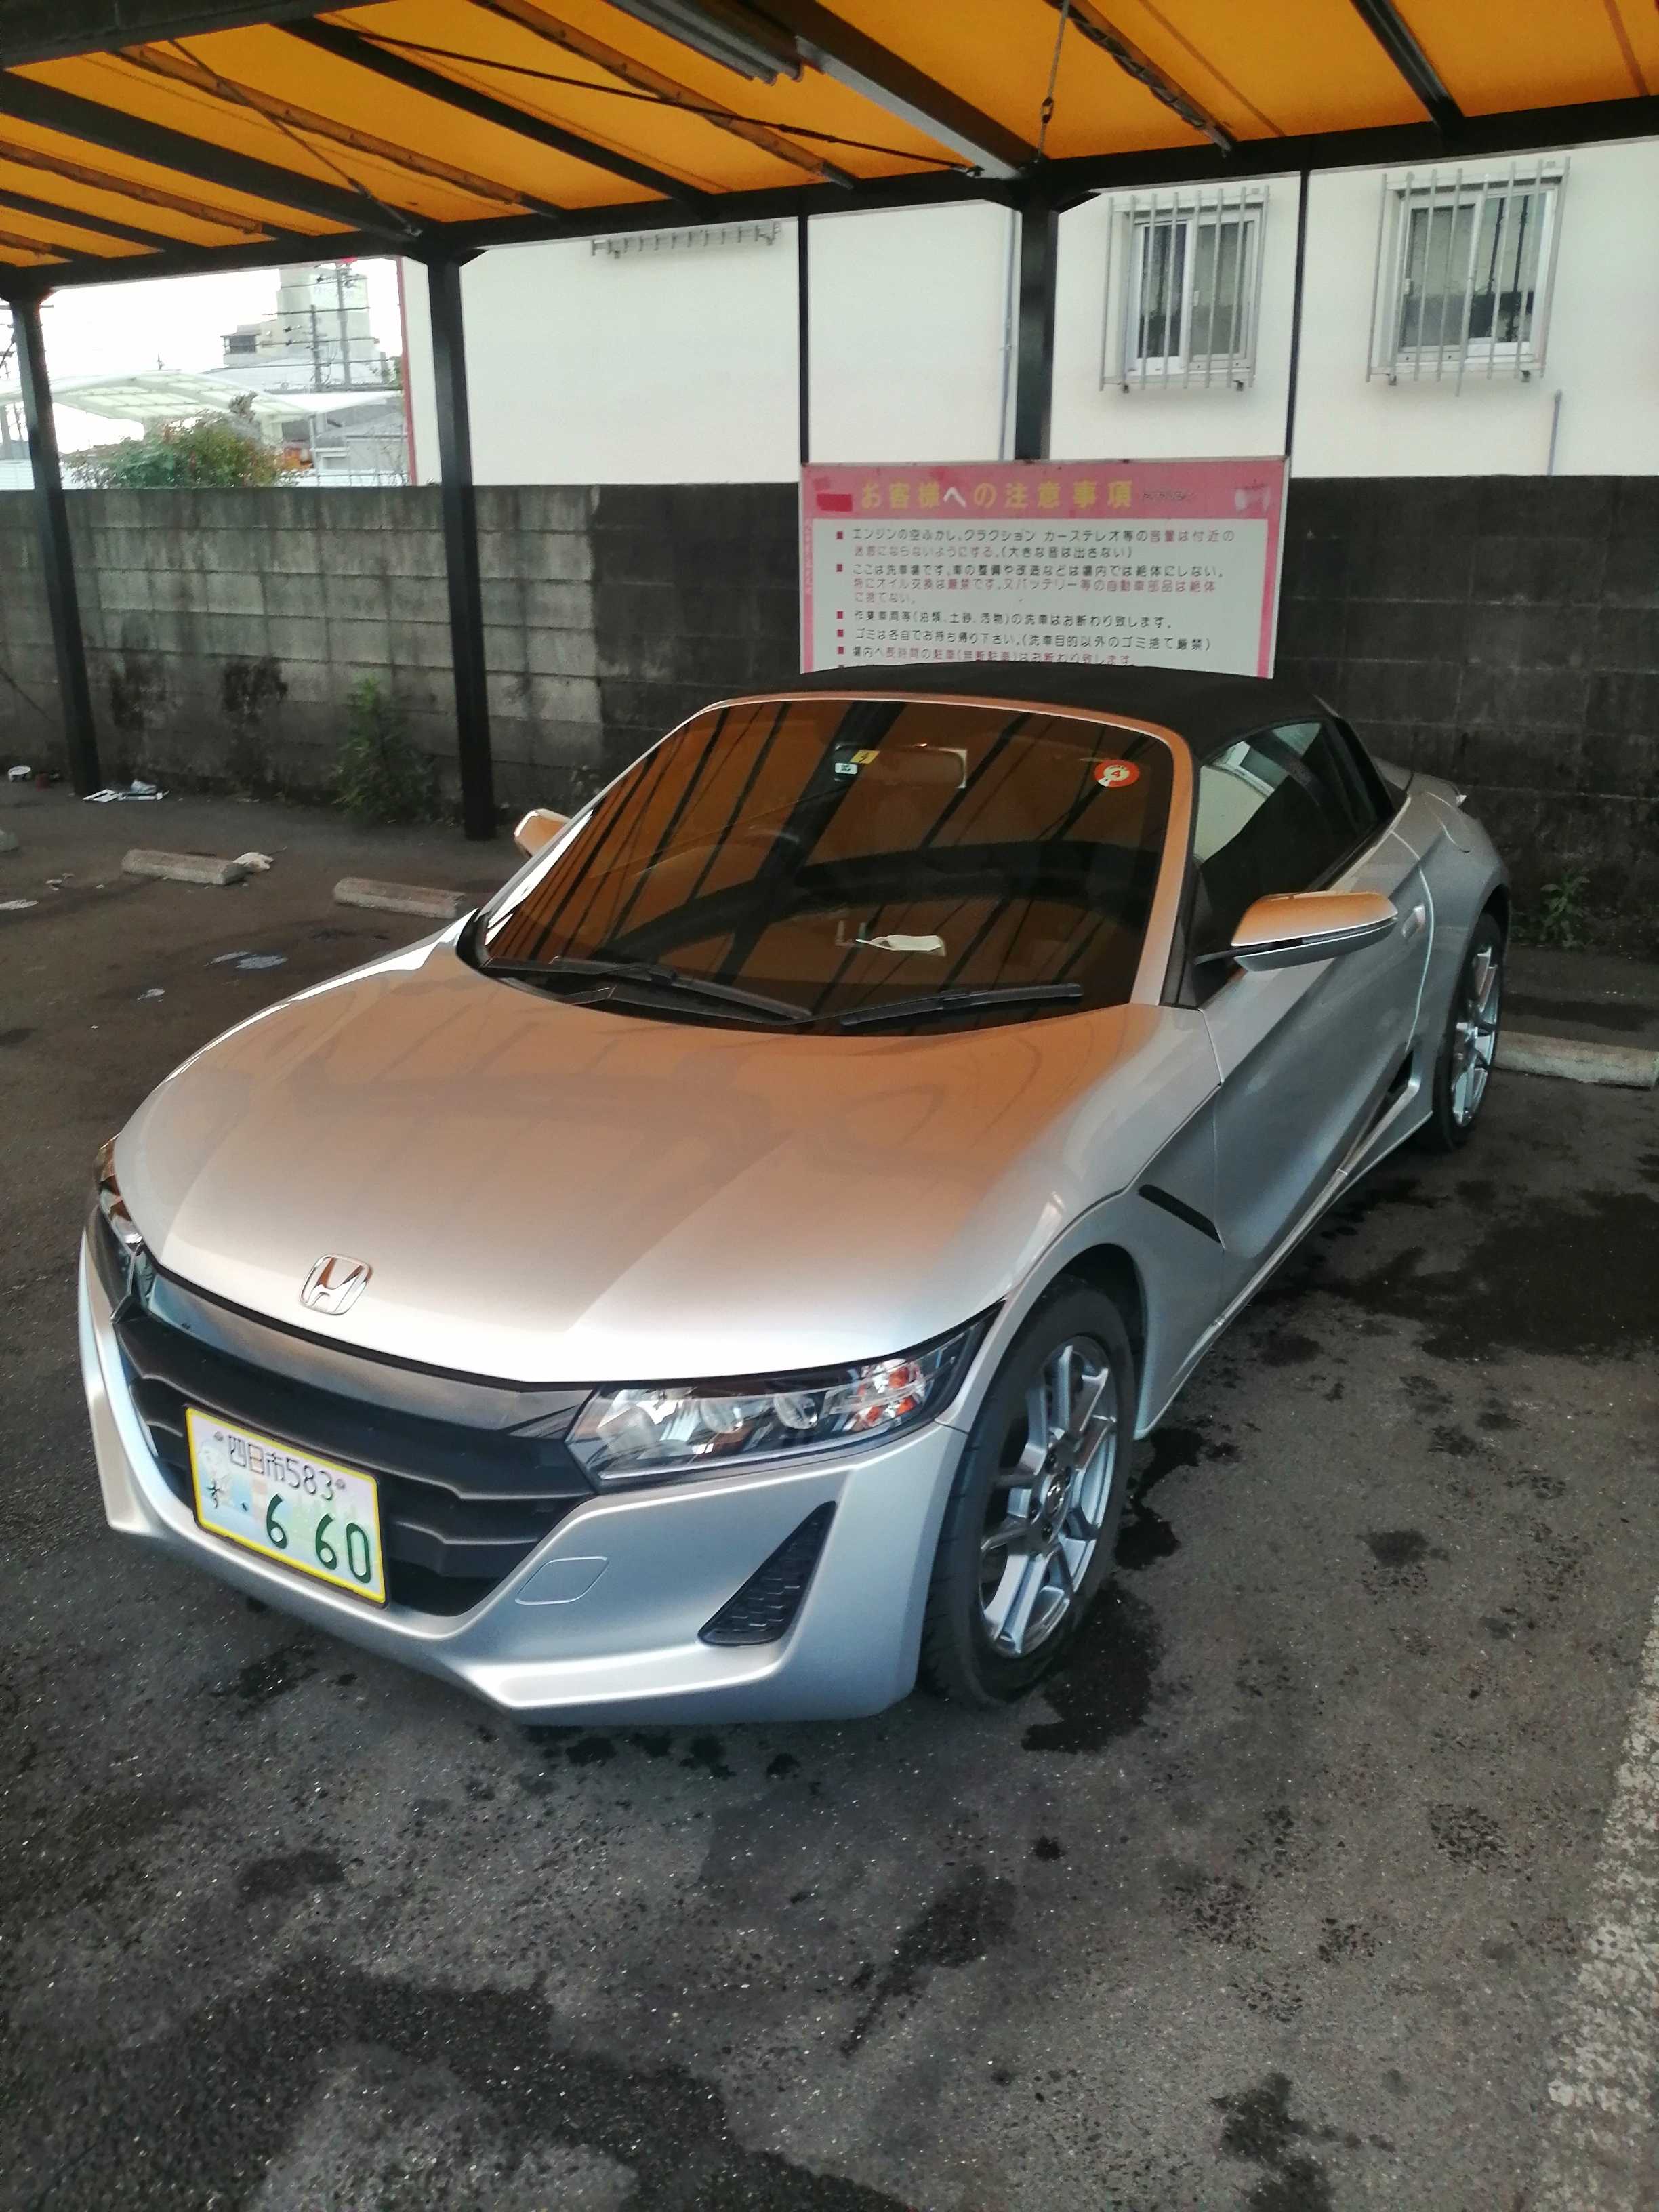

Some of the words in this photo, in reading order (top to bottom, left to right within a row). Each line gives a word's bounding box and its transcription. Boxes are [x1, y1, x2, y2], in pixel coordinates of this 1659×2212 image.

[861, 480, 1132, 509] お客様への注意事項
